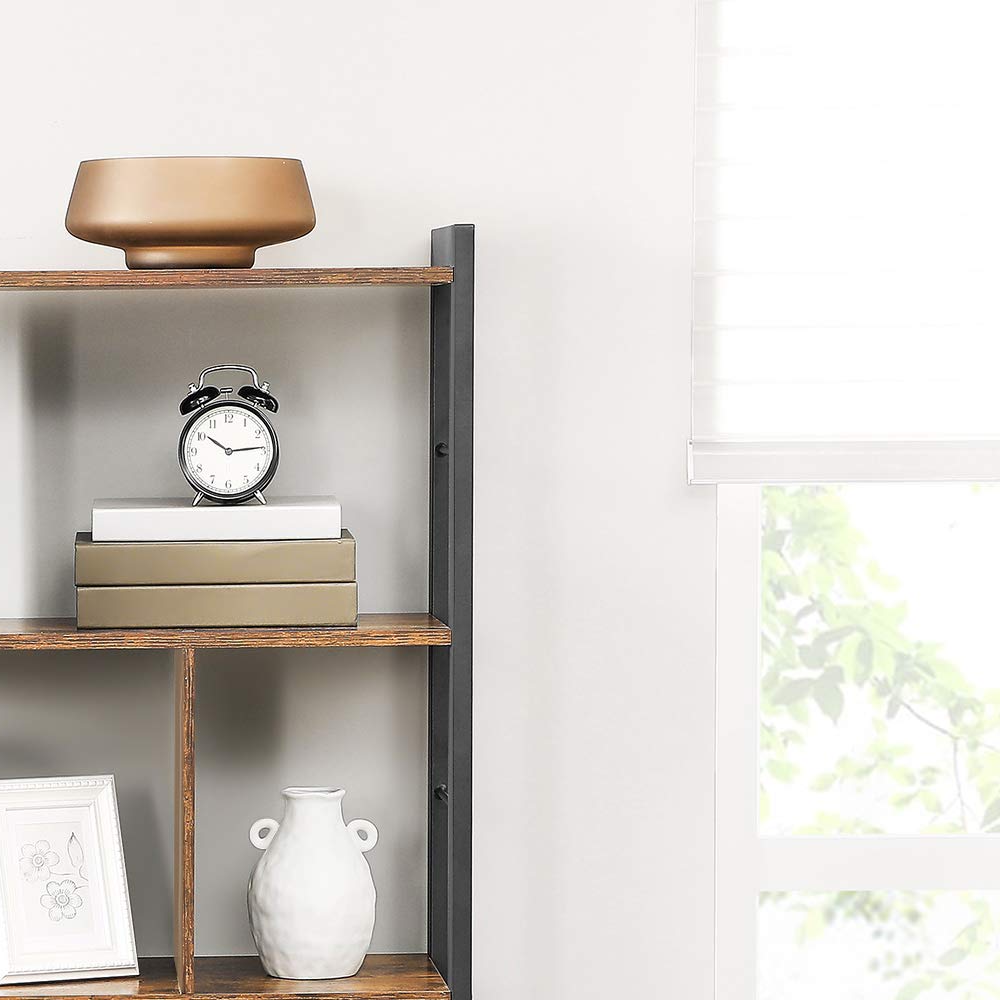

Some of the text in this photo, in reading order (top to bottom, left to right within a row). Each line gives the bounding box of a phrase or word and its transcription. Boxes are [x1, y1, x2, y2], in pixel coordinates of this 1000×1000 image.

[224, 413, 234, 424] 12
[209, 419, 217, 429] 11
[197, 432, 206, 441] 10
[255, 430, 261, 439] 2
[191, 447, 197, 456] 9
[196, 464, 202, 472] 8
[254, 463, 260, 471] 4
[209, 474, 215, 484] 7
[225, 479, 232, 488] 6
[243, 475, 249, 484] 5
